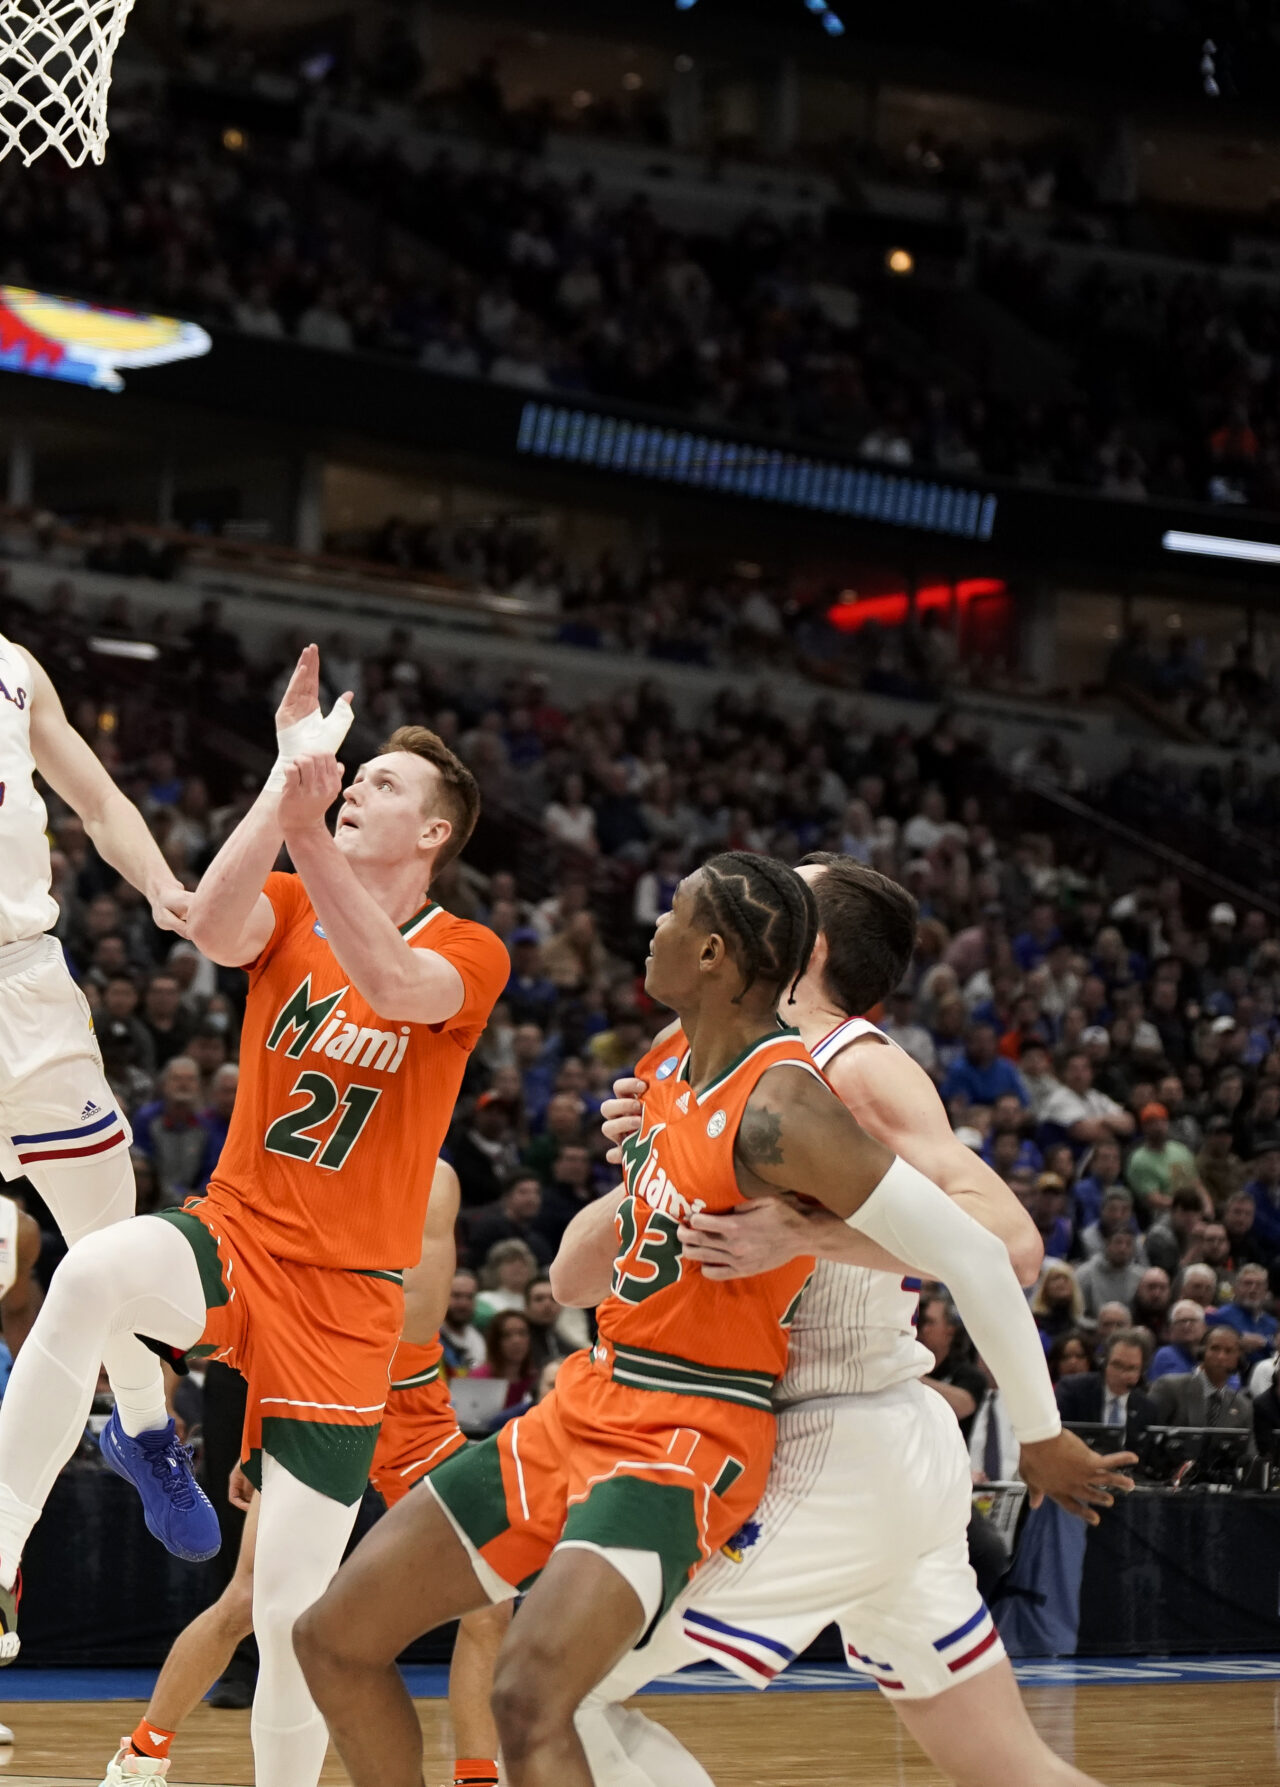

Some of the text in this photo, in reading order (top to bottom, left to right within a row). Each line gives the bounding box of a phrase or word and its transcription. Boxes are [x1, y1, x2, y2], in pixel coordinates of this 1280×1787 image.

[265, 972, 411, 1074] Miami
[81, 1106, 102, 1121] adidas
[264, 1070, 383, 1172] 21
